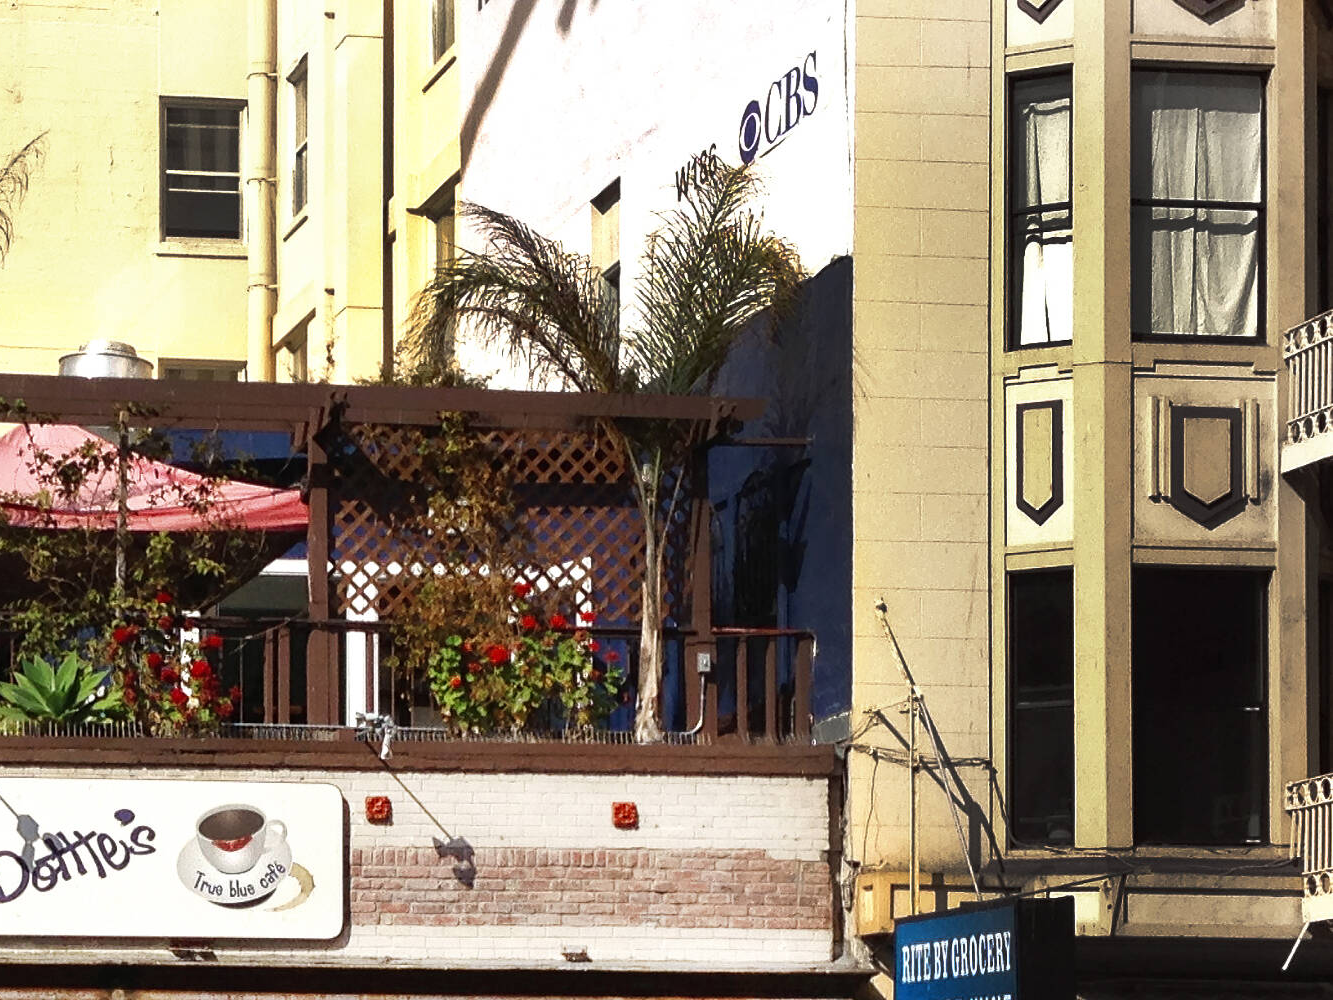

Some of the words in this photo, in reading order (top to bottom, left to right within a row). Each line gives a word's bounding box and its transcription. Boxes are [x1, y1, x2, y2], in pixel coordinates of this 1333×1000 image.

[764, 50, 819, 144] CBS
[194, 870, 223, 896] True
[229, 879, 255, 897] blue
[901, 943, 931, 984] RITE
[933, 940, 949, 980] BY
[951, 931, 1011, 978] GROCERY
